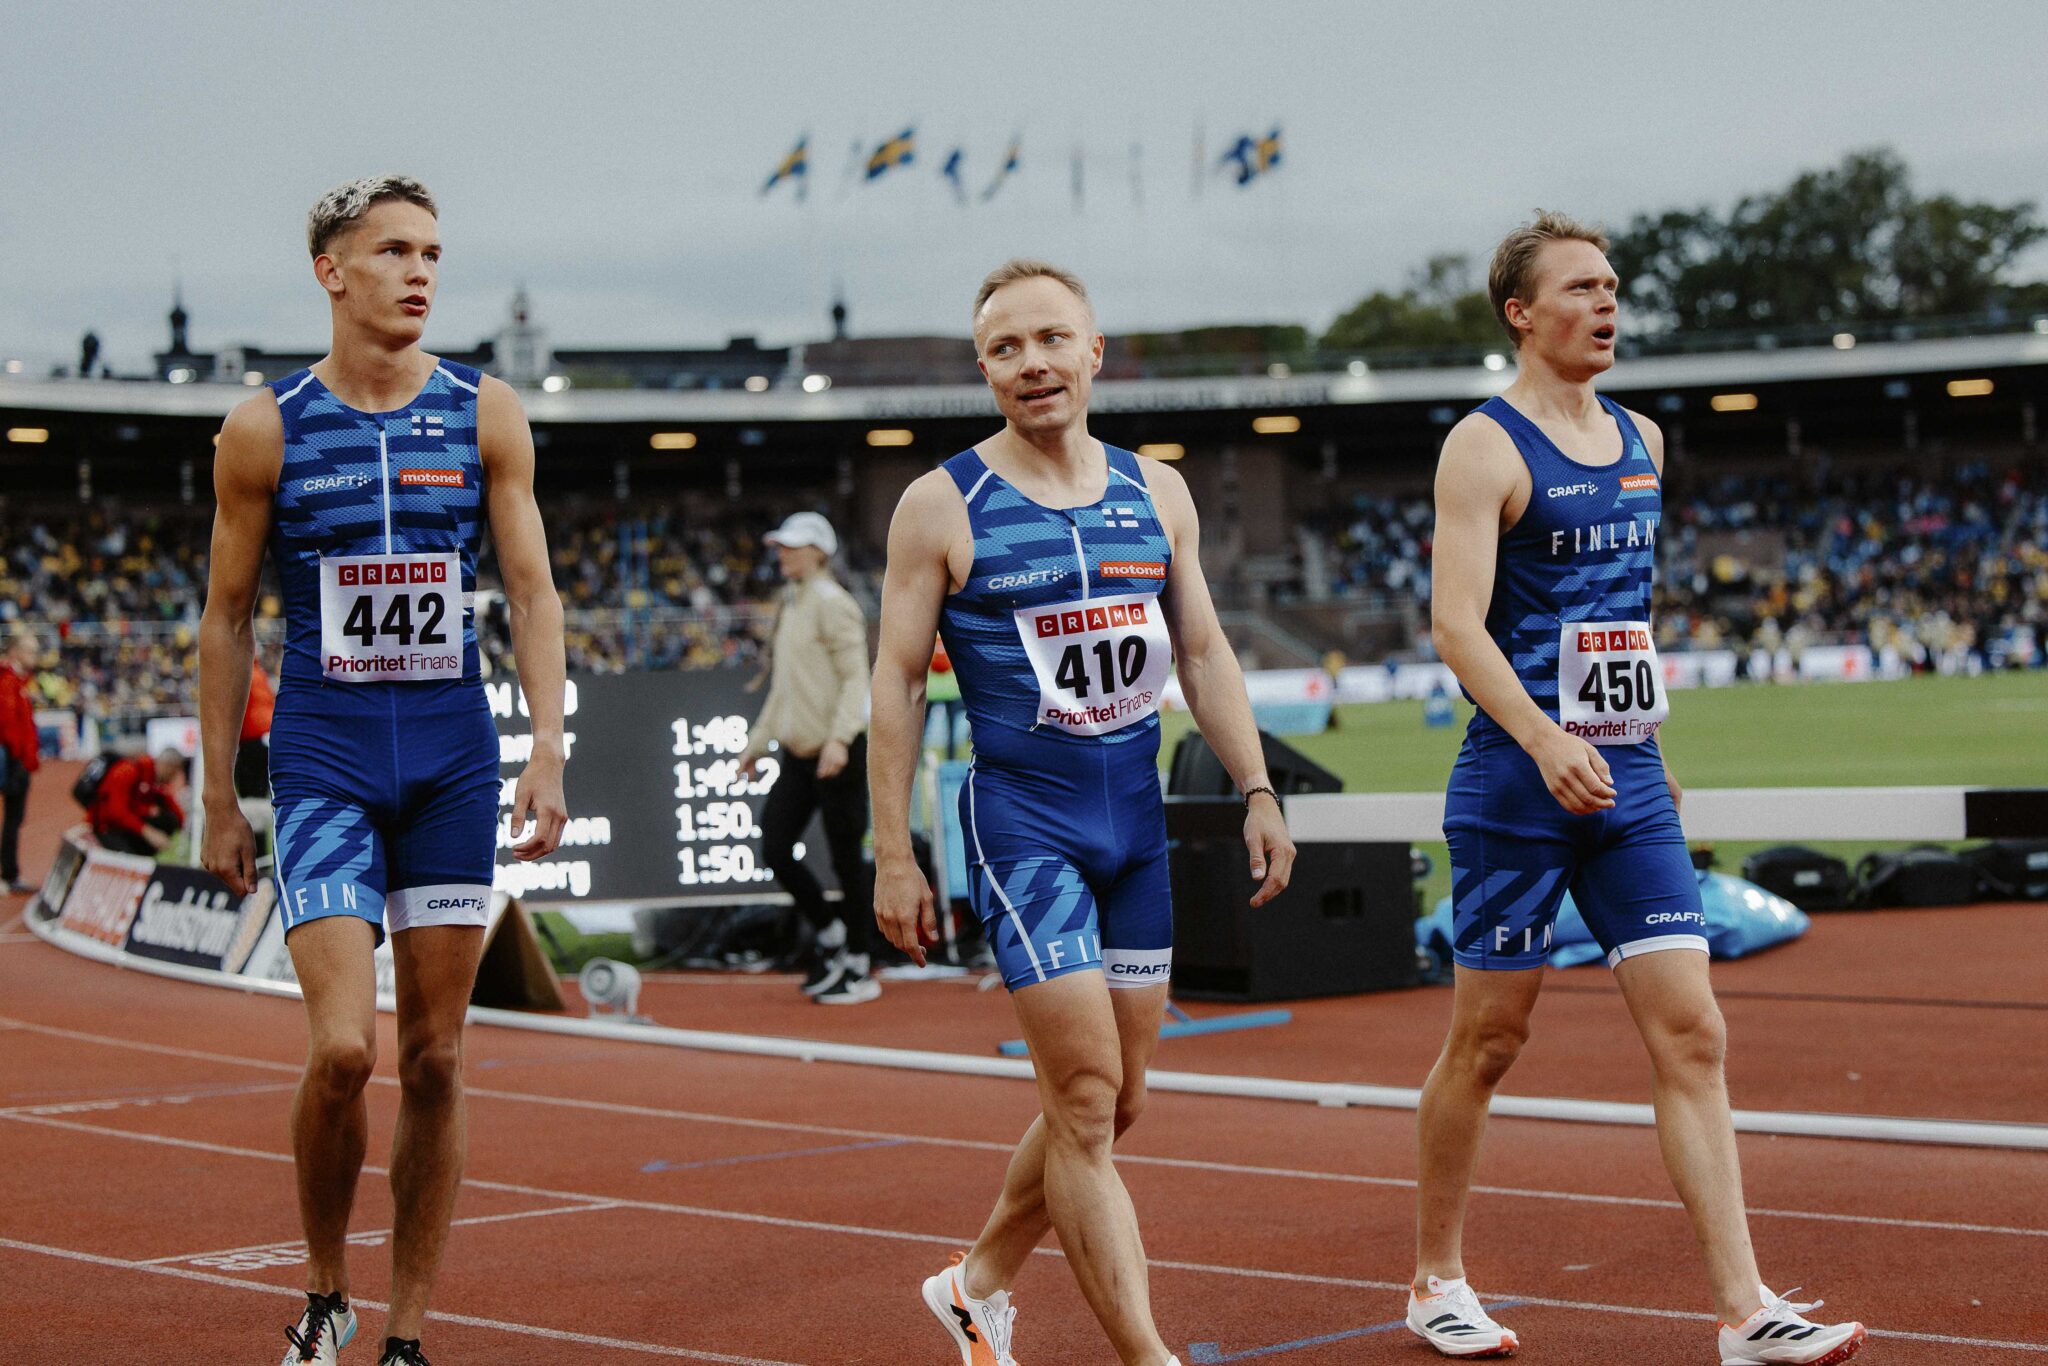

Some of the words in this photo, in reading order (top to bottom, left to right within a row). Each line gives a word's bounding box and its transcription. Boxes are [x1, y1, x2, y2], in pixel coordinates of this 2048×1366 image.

[303, 475, 356, 491] CRAFT
[403, 473, 462, 484] motonet
[1547, 484, 1587, 498] CRAFT
[1552, 519, 1656, 555] FINLAN
[341, 564, 444, 583] CRAMO
[1103, 564, 1165, 576] motonet
[988, 570, 1051, 590] CRAFT
[343, 592, 447, 646] 442
[1038, 605, 1145, 635] CRAMO
[1580, 632, 1647, 650] CRAMO
[328, 655, 406, 673] Prioritet
[410, 653, 458, 671] Finans
[1055, 635, 1147, 699] 410
[1578, 660, 1655, 713] 450
[1045, 703, 1117, 726] Prioritet
[1118, 690, 1153, 717] Finans
[671, 715, 779, 755] 1:48
[1565, 720, 1627, 738] Prioritet
[295, 883, 358, 916] FIN
[427, 899, 478, 910] CRAFT
[1645, 912, 1700, 925] CRAFT
[1110, 963, 1166, 975] CRAFT
